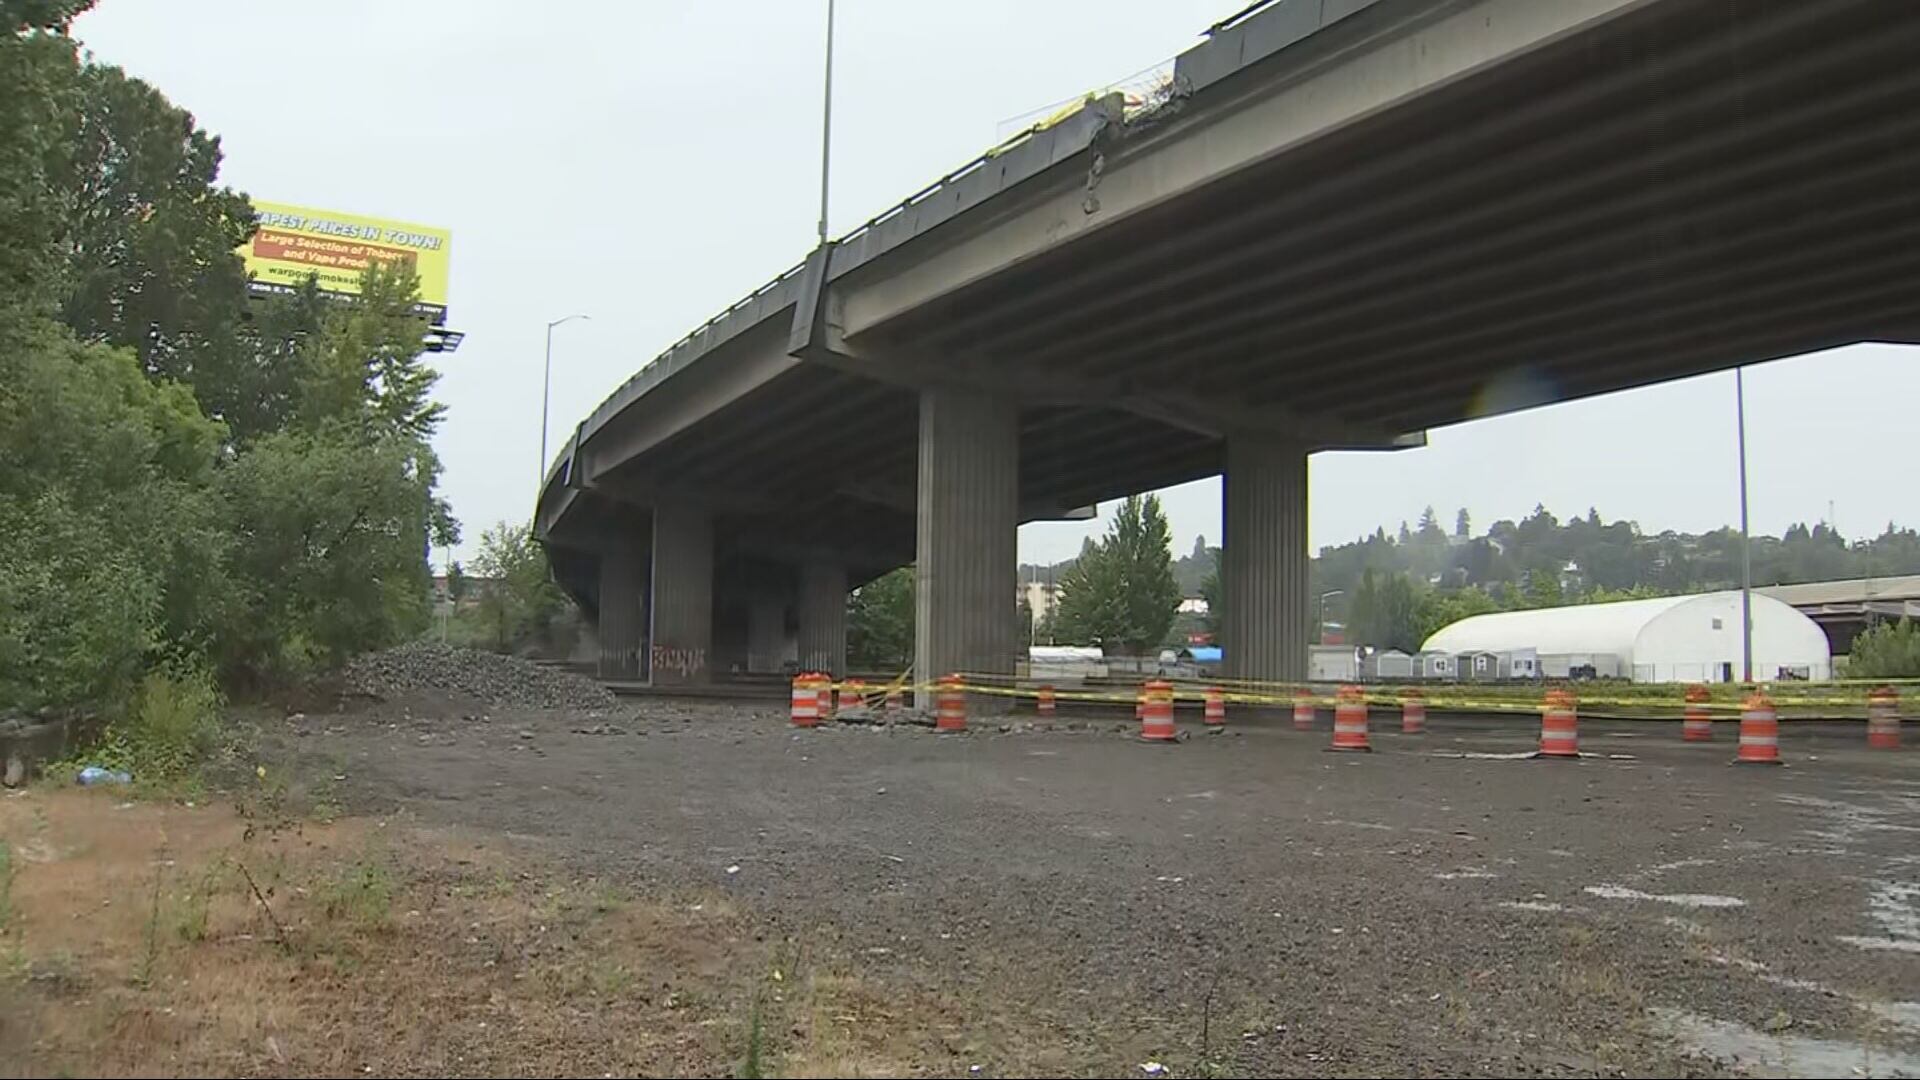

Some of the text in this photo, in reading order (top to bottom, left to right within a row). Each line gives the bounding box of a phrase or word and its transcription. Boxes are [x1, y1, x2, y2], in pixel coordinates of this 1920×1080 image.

[261, 232, 295, 246] Large
[296, 237, 349, 253] Selection
[351, 246, 365, 255] of
[308, 219, 361, 240] PRICES
[361, 226, 381, 241] IN
[384, 229, 443, 251] TOWN!
[282, 249, 307, 260] and
[308, 251, 337, 265] Vape
